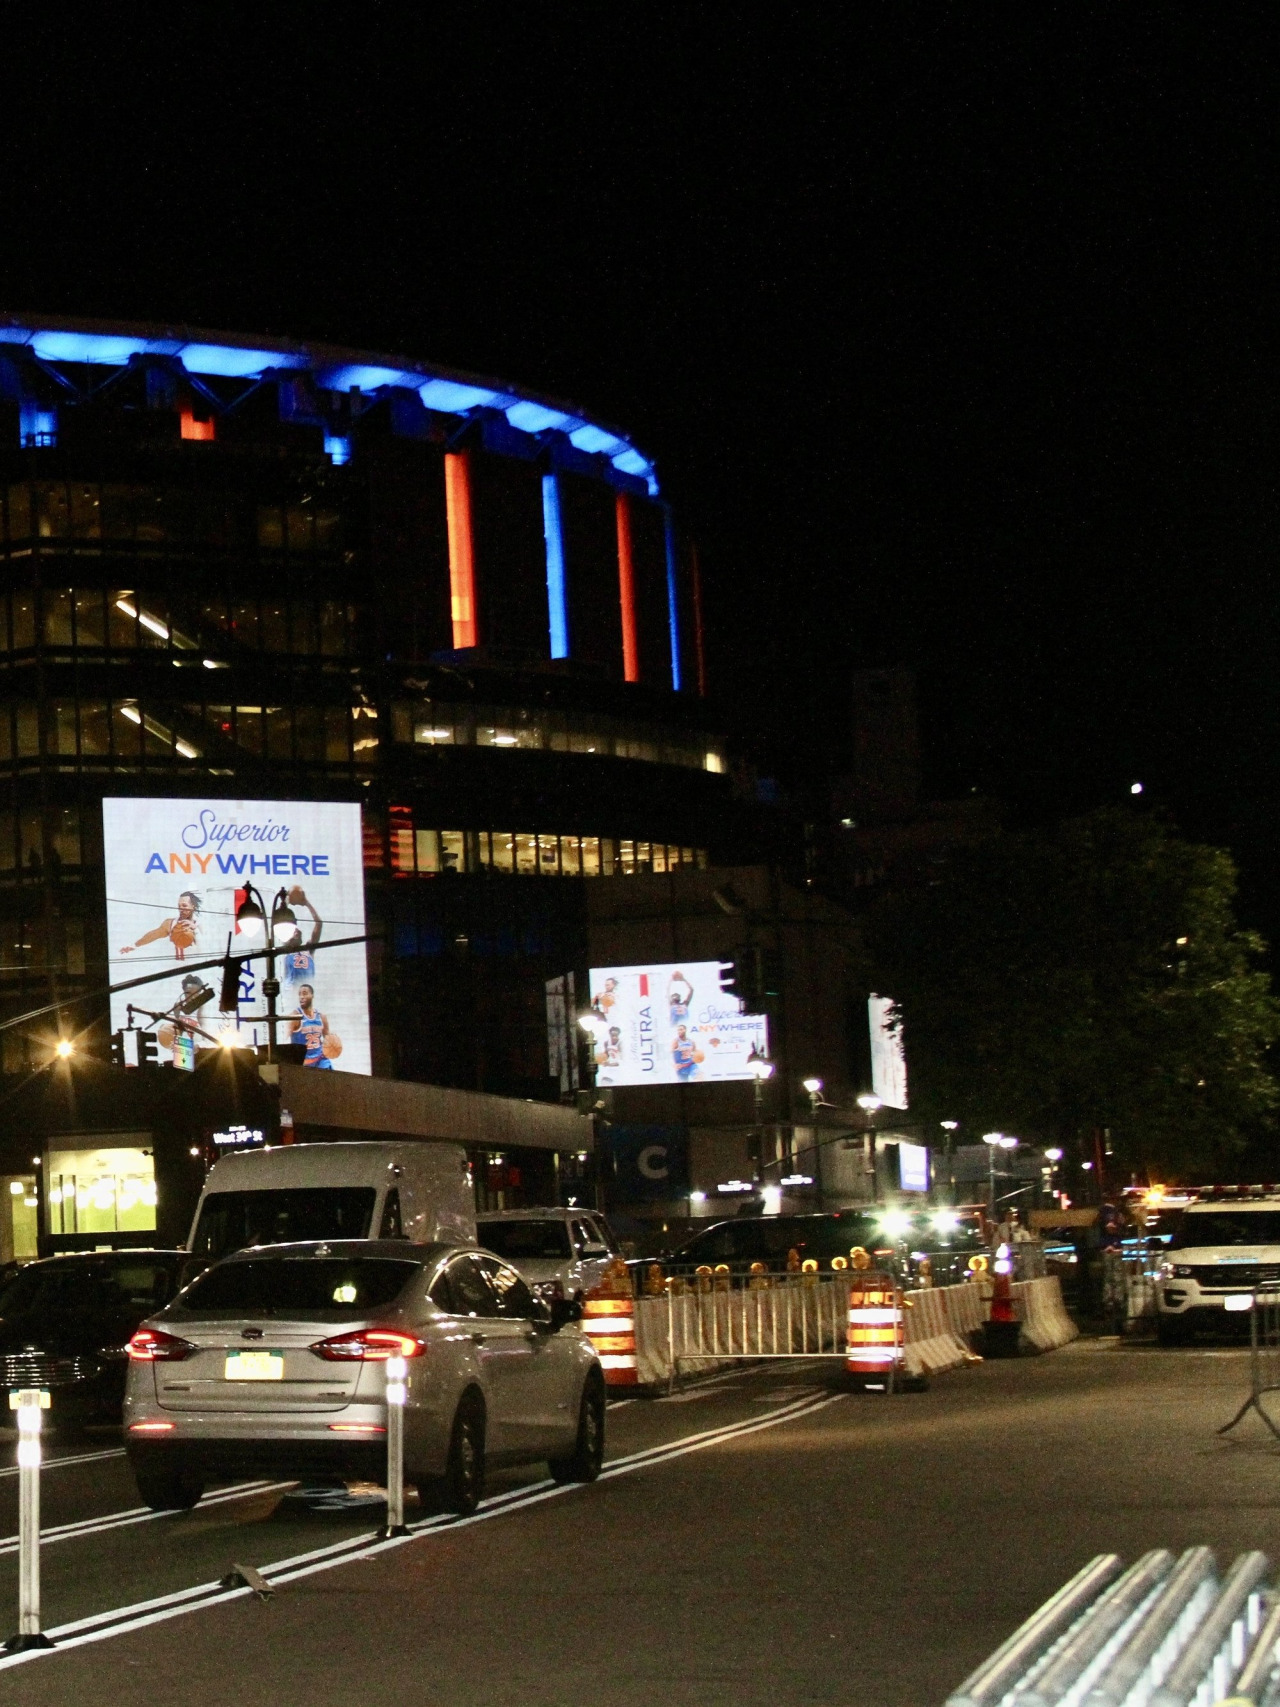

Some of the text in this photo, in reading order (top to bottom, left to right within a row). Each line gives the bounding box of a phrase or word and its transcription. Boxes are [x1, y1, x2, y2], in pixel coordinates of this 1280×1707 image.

[182, 808, 290, 851] Superior
[144, 852, 330, 876] ANYWHERE
[293, 954, 309, 969] 23
[639, 1006, 654, 1072] ULTRA
[690, 1022, 763, 1033] ANYWHERE
[305, 1033, 320, 1050] 25
[637, 1145, 669, 1179] C
